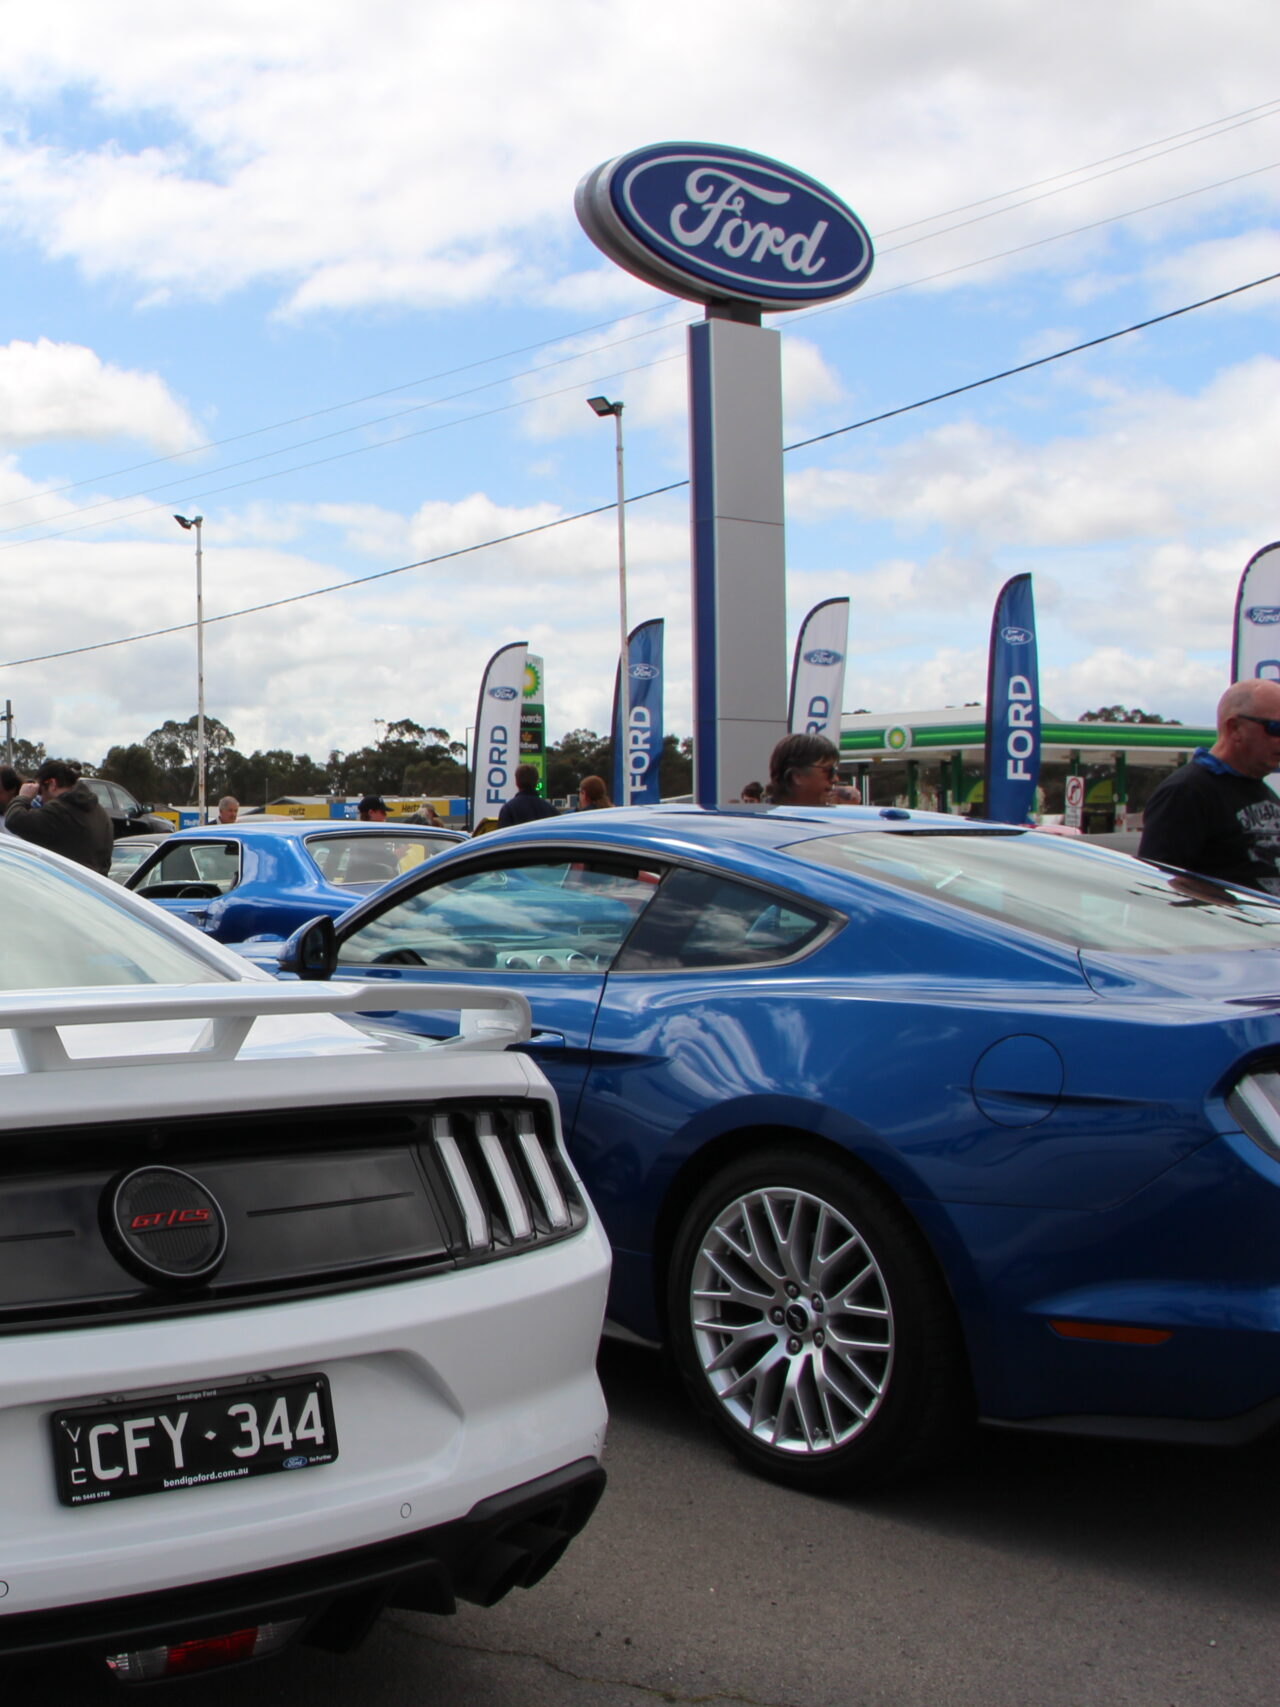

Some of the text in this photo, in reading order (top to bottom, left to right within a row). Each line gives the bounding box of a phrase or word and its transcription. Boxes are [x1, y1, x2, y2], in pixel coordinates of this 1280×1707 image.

[670, 167, 828, 276] Ford
[629, 705, 651, 793] FORD
[806, 695, 830, 735] RD
[1007, 674, 1034, 781] FORD
[486, 725, 508, 804] FORD
[67, 1427, 87, 1485] VIC
[88, 1392, 325, 1481] CFY 344
[163, 1466, 249, 1489] bendigoford.com.au
